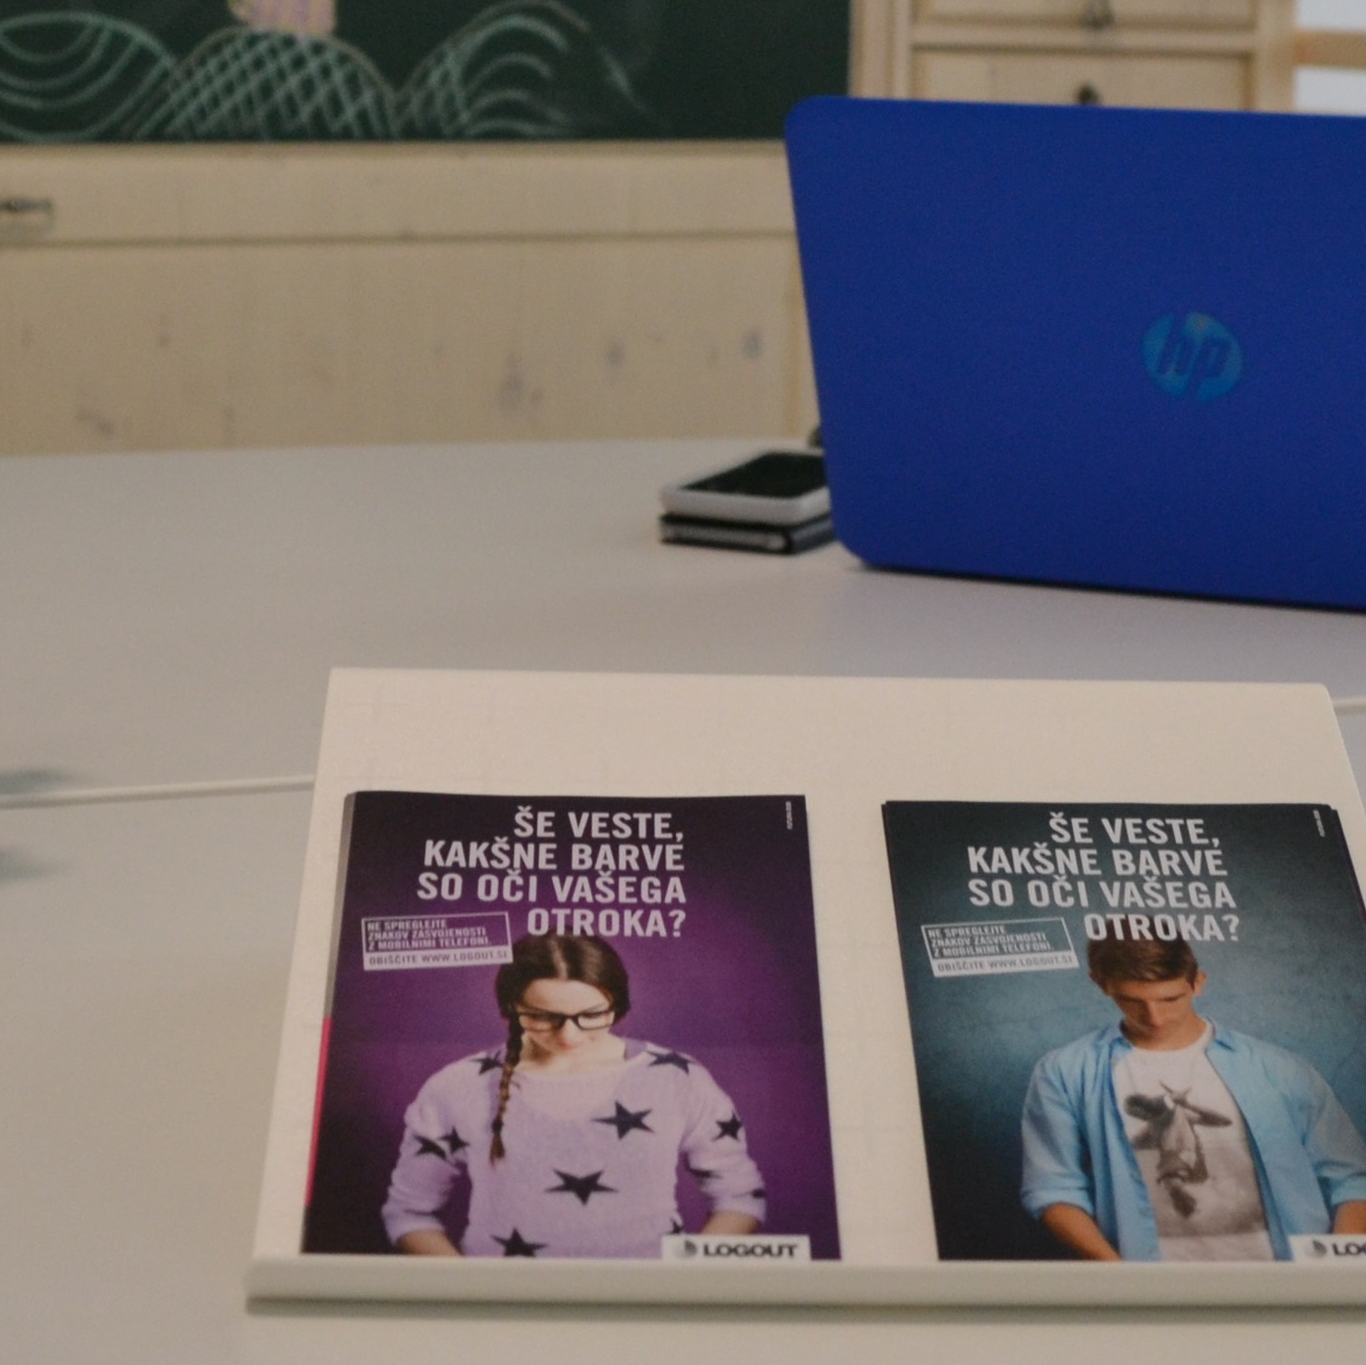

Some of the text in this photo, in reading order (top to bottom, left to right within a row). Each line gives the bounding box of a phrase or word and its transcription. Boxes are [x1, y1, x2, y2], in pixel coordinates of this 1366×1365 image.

[513, 806, 685, 843] ŠE VESTE,
[1049, 811, 1221, 848] ŠE VESTE,
[424, 836, 685, 872] KAKŠNE BARVE
[967, 841, 1228, 877] KAKŠNE BARVE
[416, 866, 687, 904] SO OČI VAŠEGA
[968, 874, 1237, 910] SO OČI VAŠEGA
[527, 908, 687, 938] OTROKA?
[1084, 913, 1241, 943] OTROKA?
[703, 1242, 798, 1258] LOGOUT
